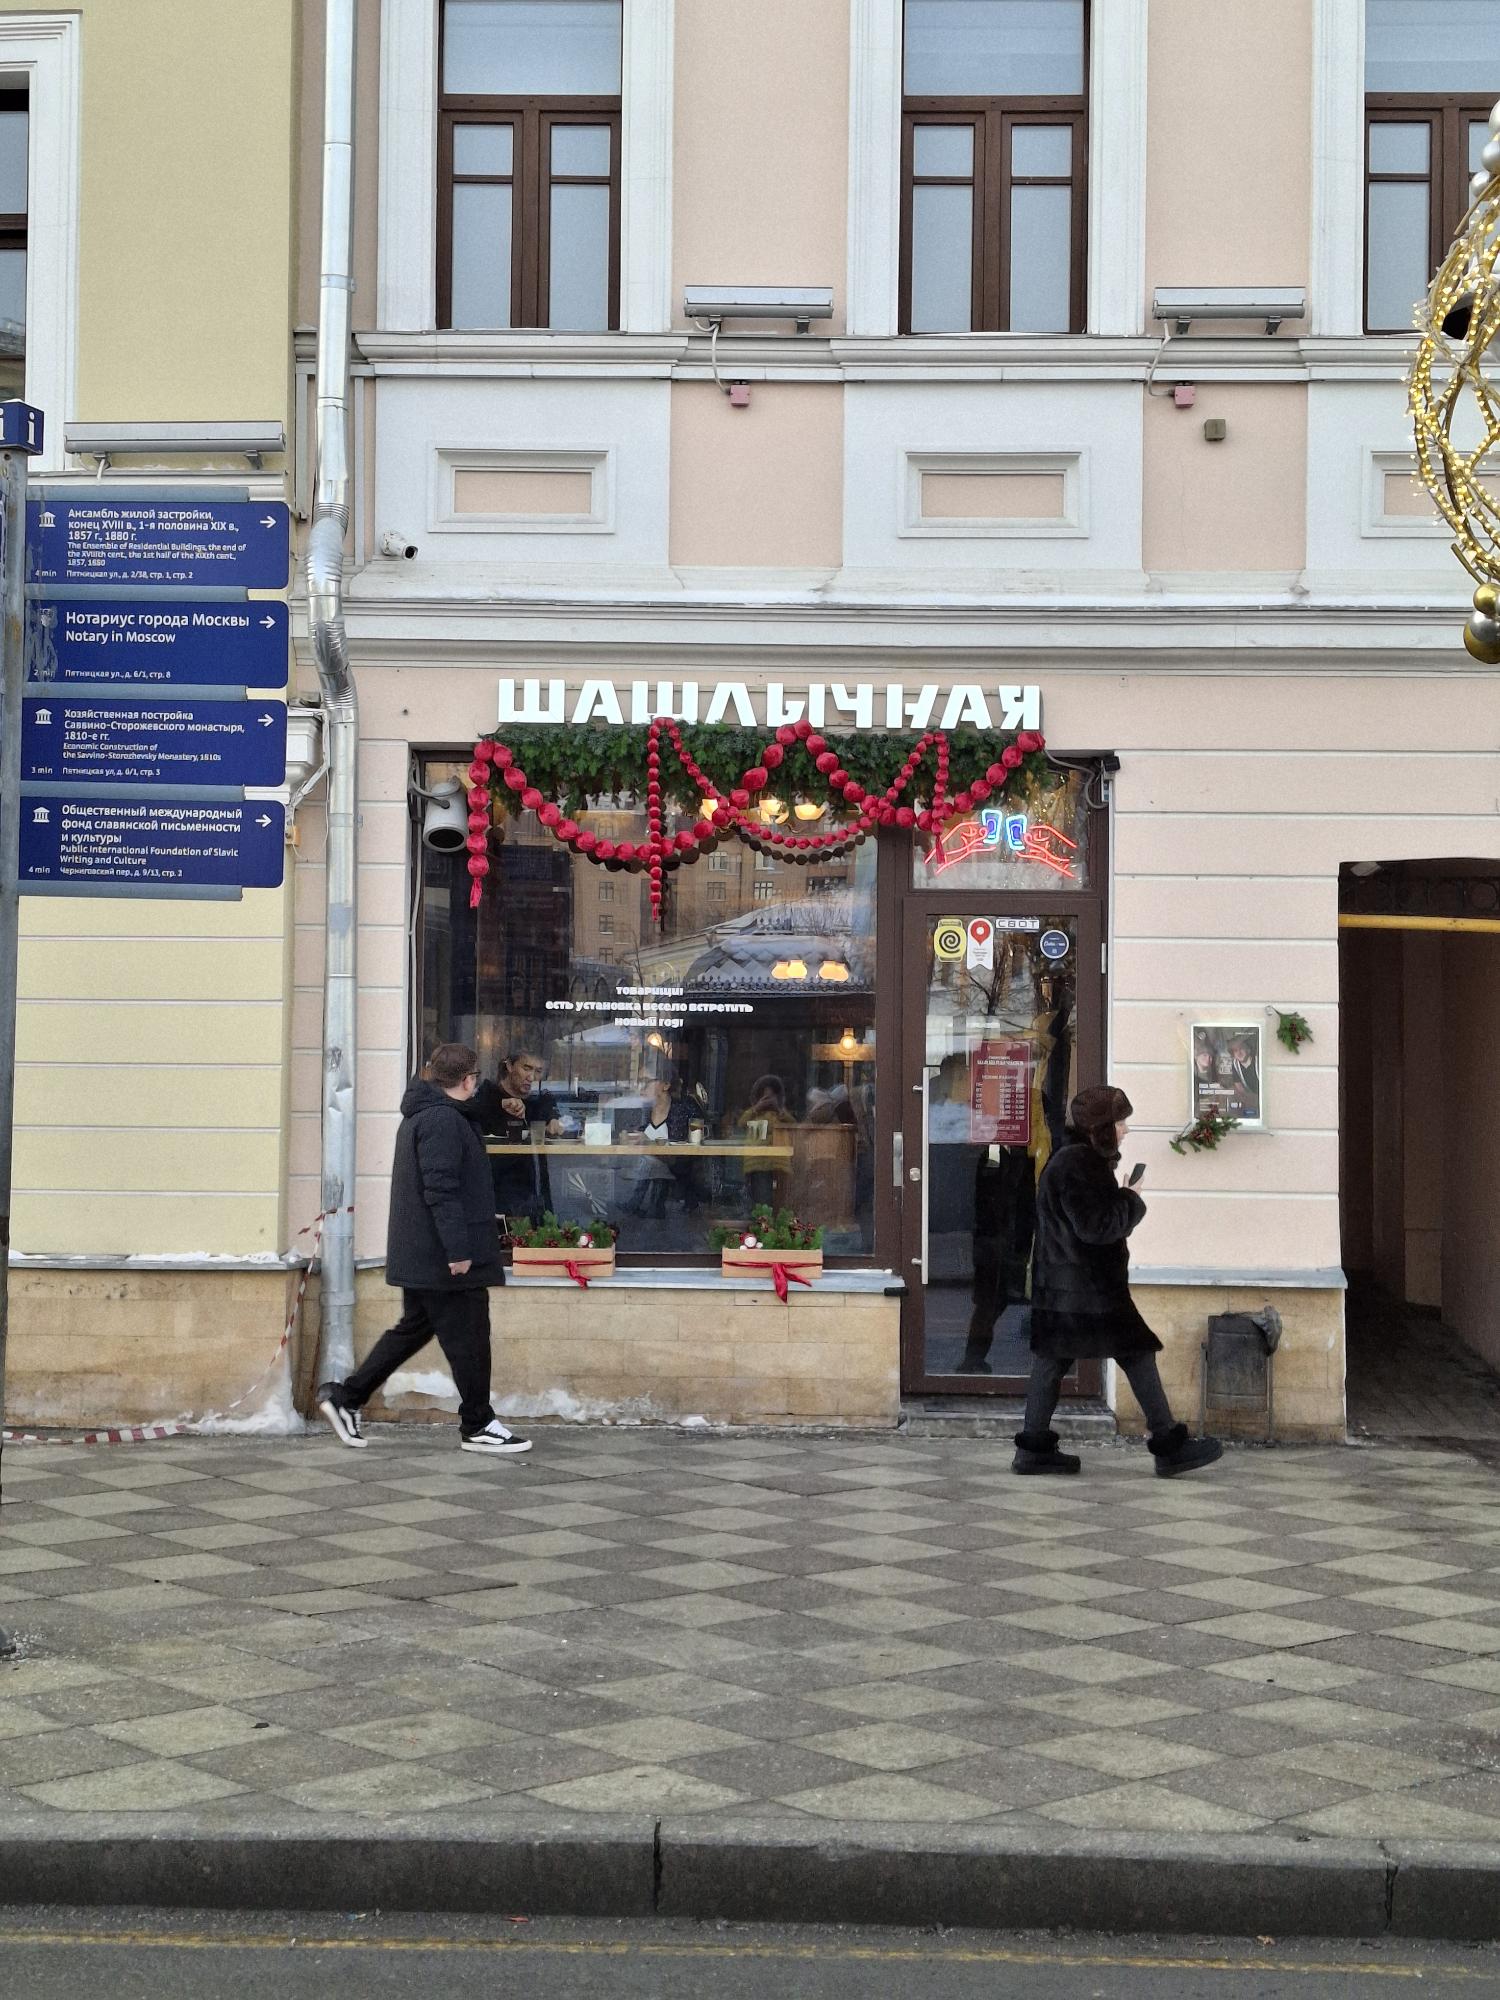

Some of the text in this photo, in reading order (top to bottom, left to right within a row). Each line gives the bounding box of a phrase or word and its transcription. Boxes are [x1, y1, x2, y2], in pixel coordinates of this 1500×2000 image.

[68, 509, 214, 521] Ансамбль жилой застройки,
[68, 522, 100, 531] конец
[102, 521, 124, 530] XVIII
[139, 522, 156, 530] 1-я
[211, 522, 226, 530] XIX
[68, 531, 92, 540] 1857
[106, 532, 128, 540] 1880
[172, 544, 206, 552] Buildings,
[66, 612, 249, 628] Нотариус города Москвы
[66, 630, 176, 644] Notary in Moscow
[66, 670, 110, 678] Пятницкая
[498, 678, 1040, 731] ШАШЛЫЧНАЯ
[64, 710, 193, 721] Хозяйственная постройка
[64, 720, 244, 734] Саввино-Сторожевского монастыря,
[64, 732, 98, 740] 1810-е
[158, 753, 198, 762] Monastery,
[62, 767, 104, 776] Пятницкая
[62, 805, 242, 818] Общественный международный
[62, 820, 240, 833] фонд славянской письменности
[72, 834, 122, 844] культуры
[60, 845, 238, 856] Public International Foundation of Slavic
[60, 856, 146, 866] Writing and Culture
[60, 868, 114, 876] Черниговский
[546, 1001, 754, 1012] есть установка весело встретить
[614, 1016, 683, 1028] новый год!
